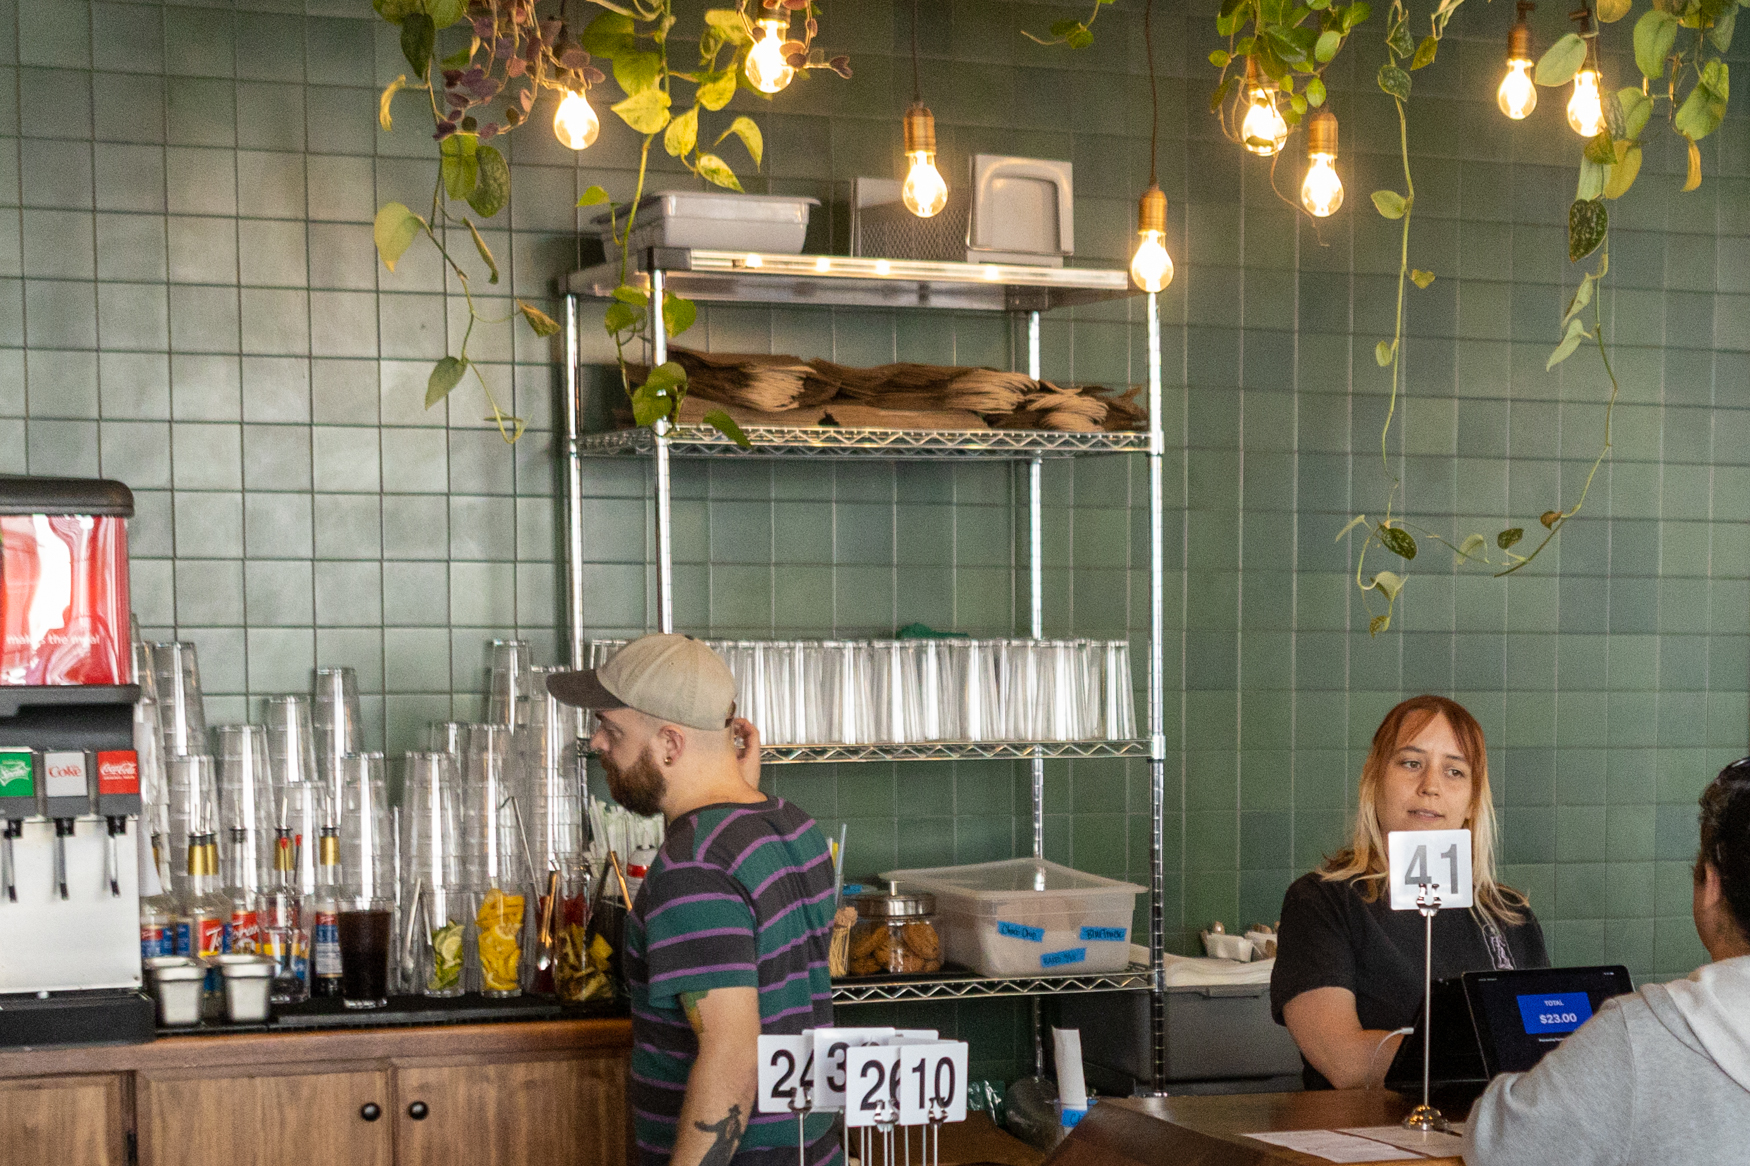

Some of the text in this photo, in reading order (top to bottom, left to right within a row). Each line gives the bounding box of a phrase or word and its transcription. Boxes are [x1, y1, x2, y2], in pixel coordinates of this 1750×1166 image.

[6, 633, 100, 645] maks the mal
[48, 764, 82, 778] Coke
[1404, 843, 1459, 895] 41
[1539, 1013, 1577, 1024] $23.00
[912, 1056, 956, 1110] 10
